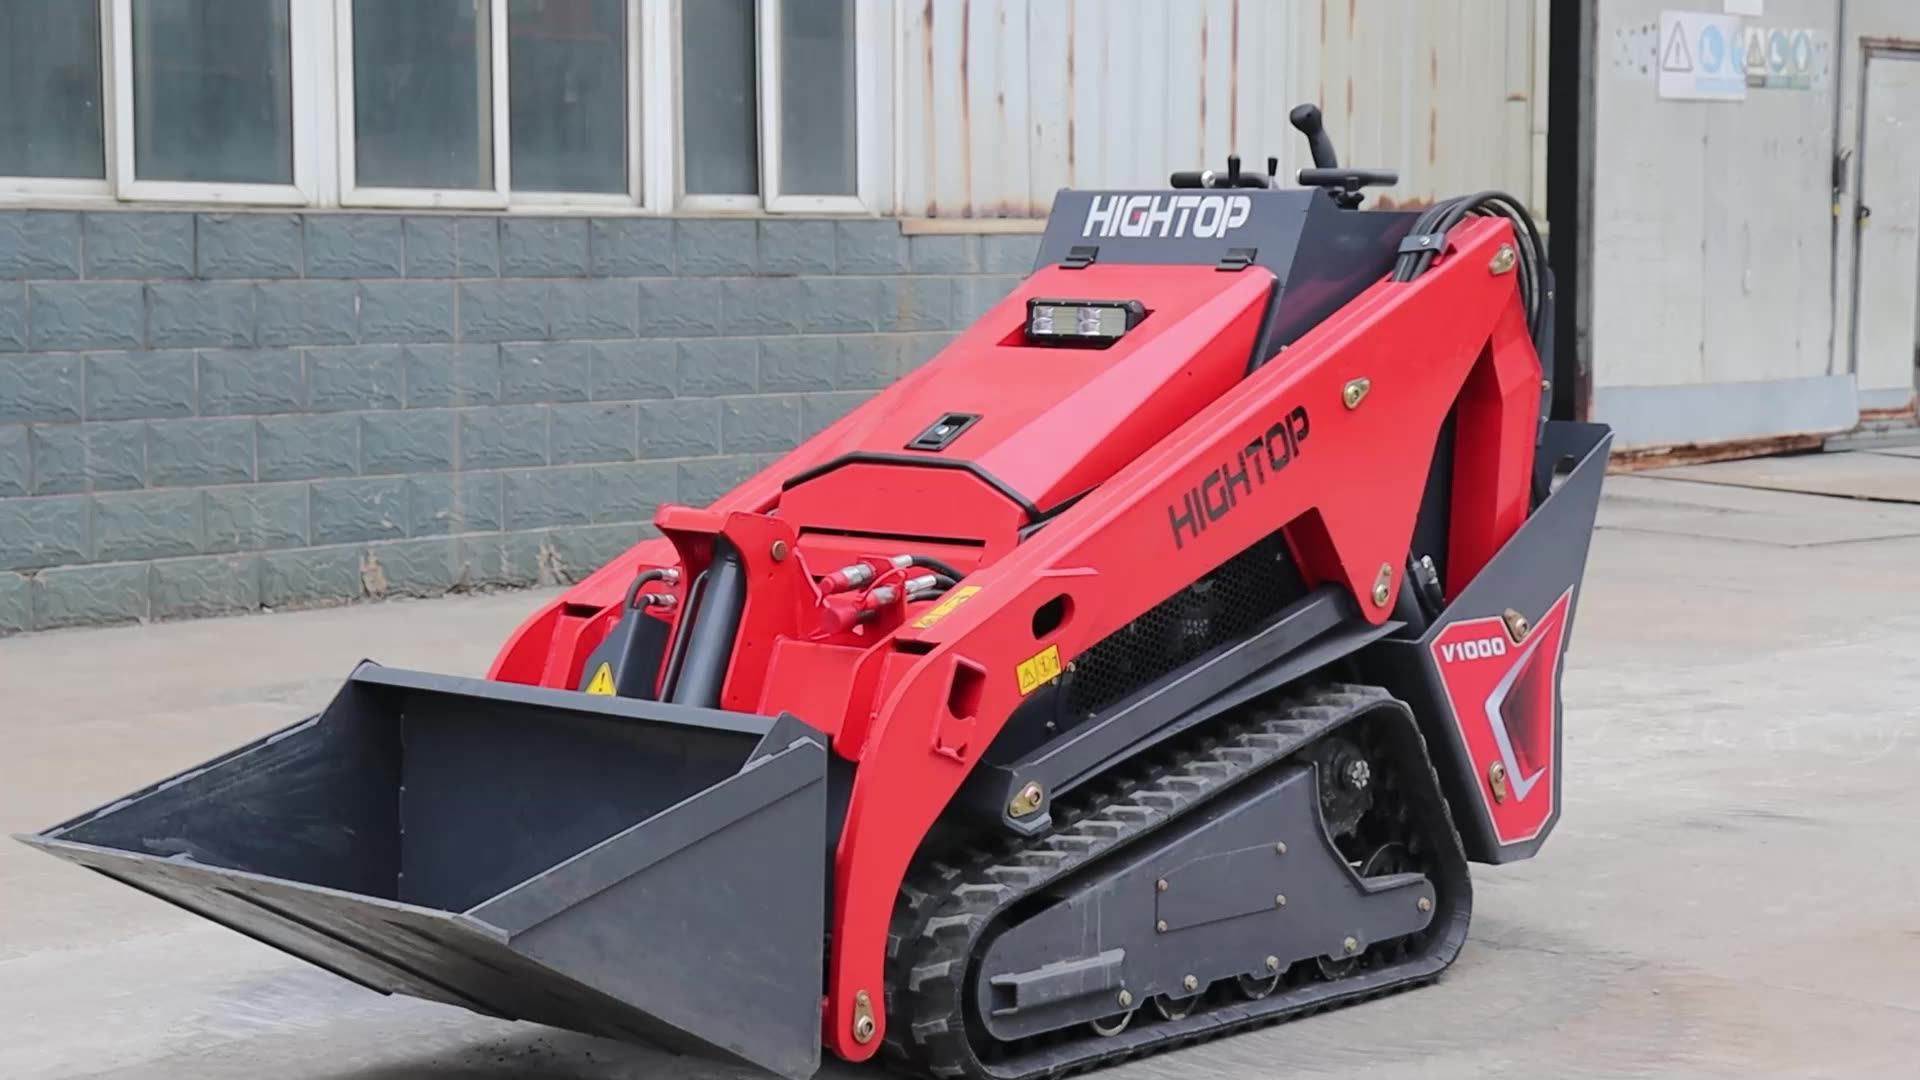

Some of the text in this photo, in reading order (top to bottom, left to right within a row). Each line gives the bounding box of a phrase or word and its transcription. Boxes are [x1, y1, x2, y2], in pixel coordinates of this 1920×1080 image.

[1082, 195, 1251, 238] HIGHTOP
[1168, 405, 1310, 550] HIGHTOP
[1441, 637, 1506, 663] V1000
